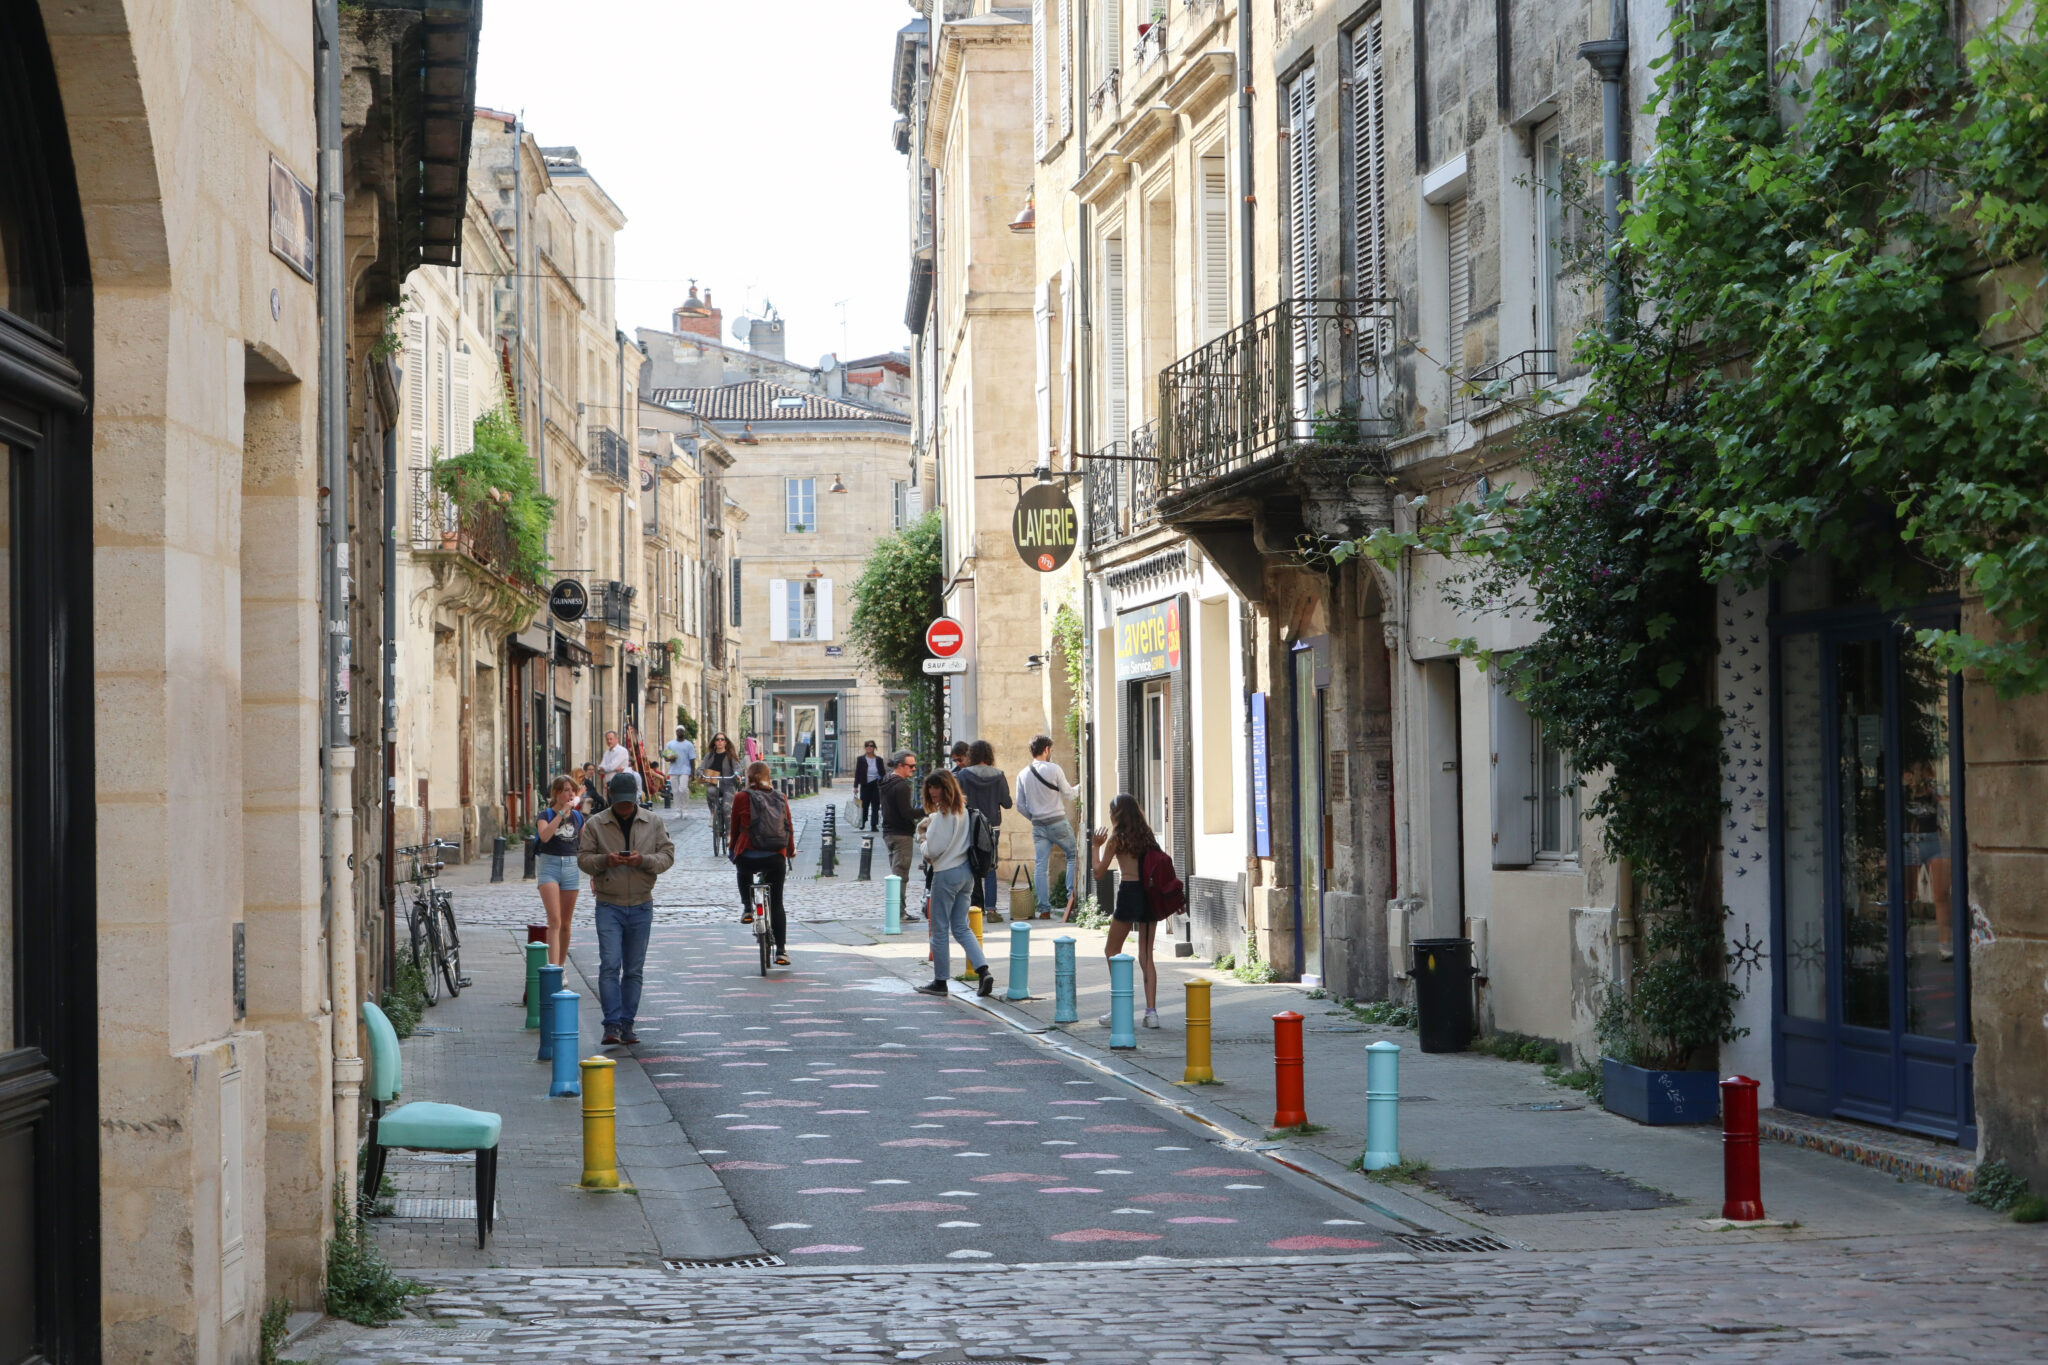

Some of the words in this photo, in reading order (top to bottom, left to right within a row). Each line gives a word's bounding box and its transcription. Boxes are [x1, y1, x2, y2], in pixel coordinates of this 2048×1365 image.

[1018, 508, 1075, 547] LAVERIE
[552, 597, 583, 605] GUINNESS
[1117, 606, 1166, 659] Laverie
[1130, 658, 1152, 674] Service
